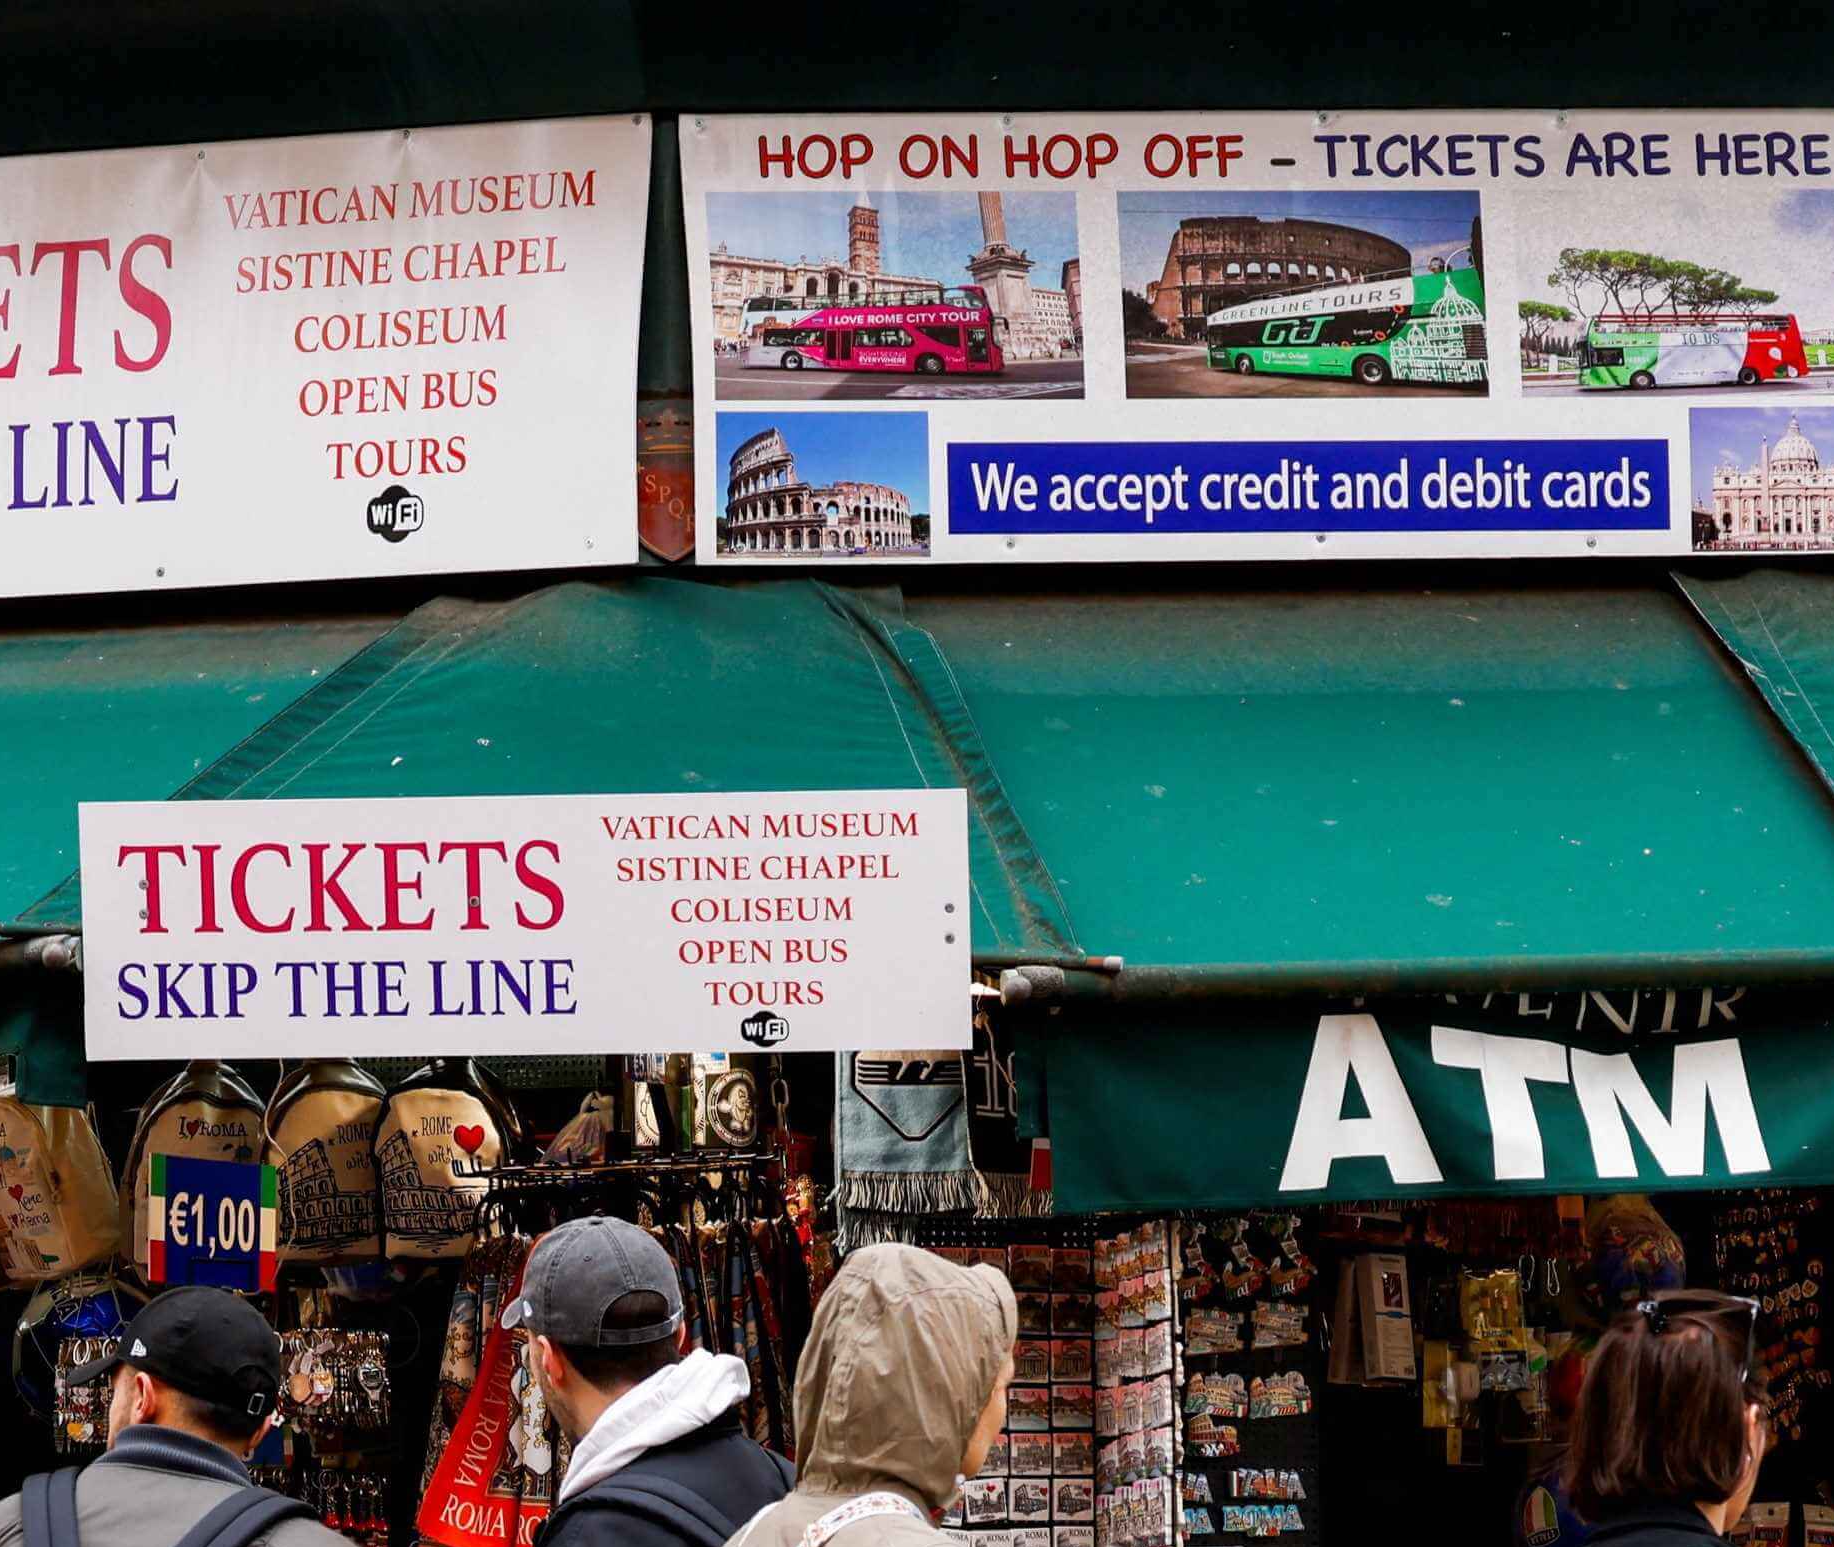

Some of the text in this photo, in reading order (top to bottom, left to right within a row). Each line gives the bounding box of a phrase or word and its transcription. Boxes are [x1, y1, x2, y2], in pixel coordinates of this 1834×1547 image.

[758, 132, 1831, 179] HOP ON HOP OFF TICKETS ARE HERE
[223, 170, 596, 236] VATICAN MUSEUM
[236, 236, 566, 294] SISTINE CHAPEL
[836, 310, 980, 325] LOVE ROME CITY TOUR
[1321, 287, 1402, 309] TOURS
[293, 304, 507, 355] COLISEUM
[299, 370, 498, 418] OPEN BUS
[9, 416, 179, 509] LINE
[326, 436, 466, 481] TOURS
[971, 456, 1651, 522] We accept credit and debit cards
[600, 811, 919, 841] VATICAN MUSEUM
[118, 840, 566, 934] TICKETS
[617, 852, 900, 883] SISTINE CHAPEL
[671, 895, 853, 923] COLISEUM
[678, 937, 848, 965] OPEN BUS
[117, 957, 578, 1021] SKIP THE LINE
[705, 980, 824, 1007] TOURS
[1278, 1014, 1772, 1191] ATM
[198, 1120, 248, 1138] ROMA
[420, 1117, 453, 1138] ROME
[168, 1190, 256, 1258] €1,00
[453, 1412, 500, 1488] ROMA
[440, 1493, 508, 1538] ROMA
